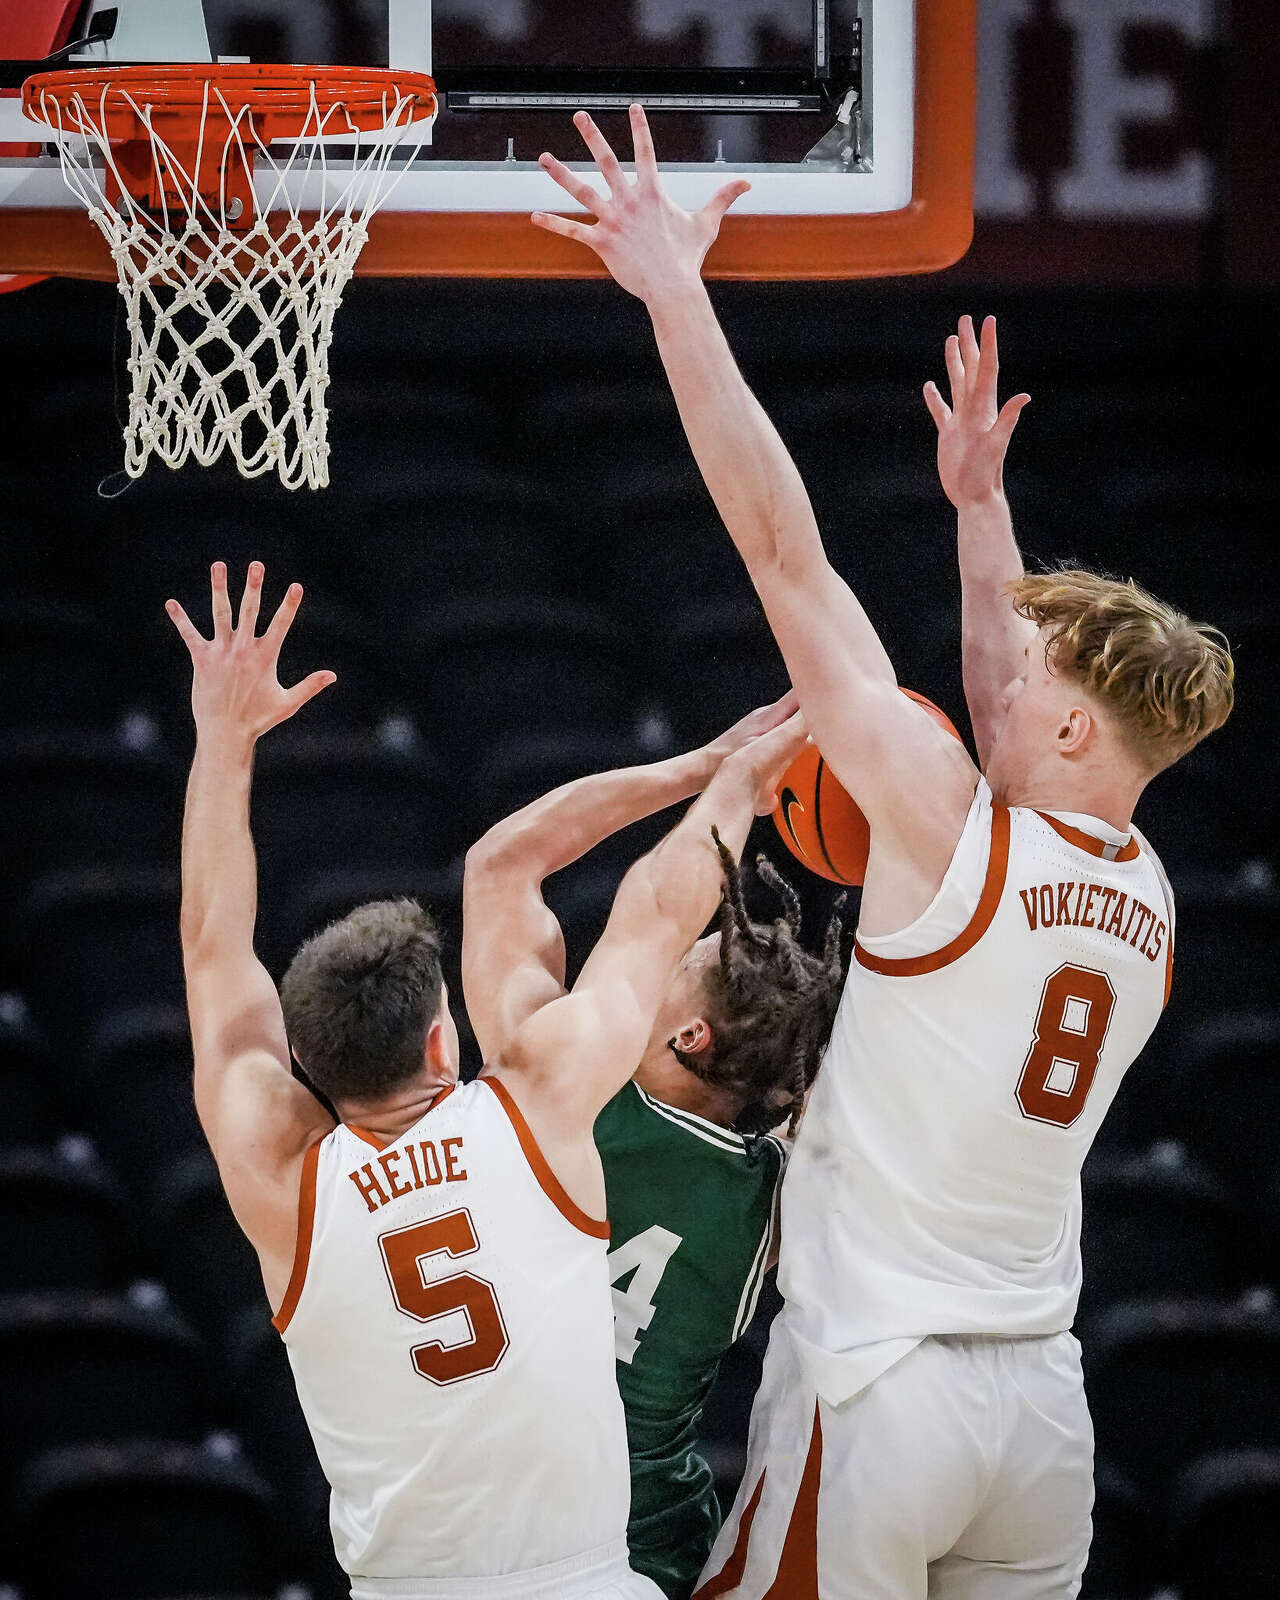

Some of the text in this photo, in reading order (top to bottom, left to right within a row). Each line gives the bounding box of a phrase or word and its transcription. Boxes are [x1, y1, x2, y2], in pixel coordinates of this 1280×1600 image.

[1019, 882, 1166, 962] VOKIETAITIS
[1015, 961, 1117, 1129] 8
[349, 1137, 468, 1213] HEIDE
[377, 1207, 510, 1386] 5
[608, 1225, 683, 1365] 4
